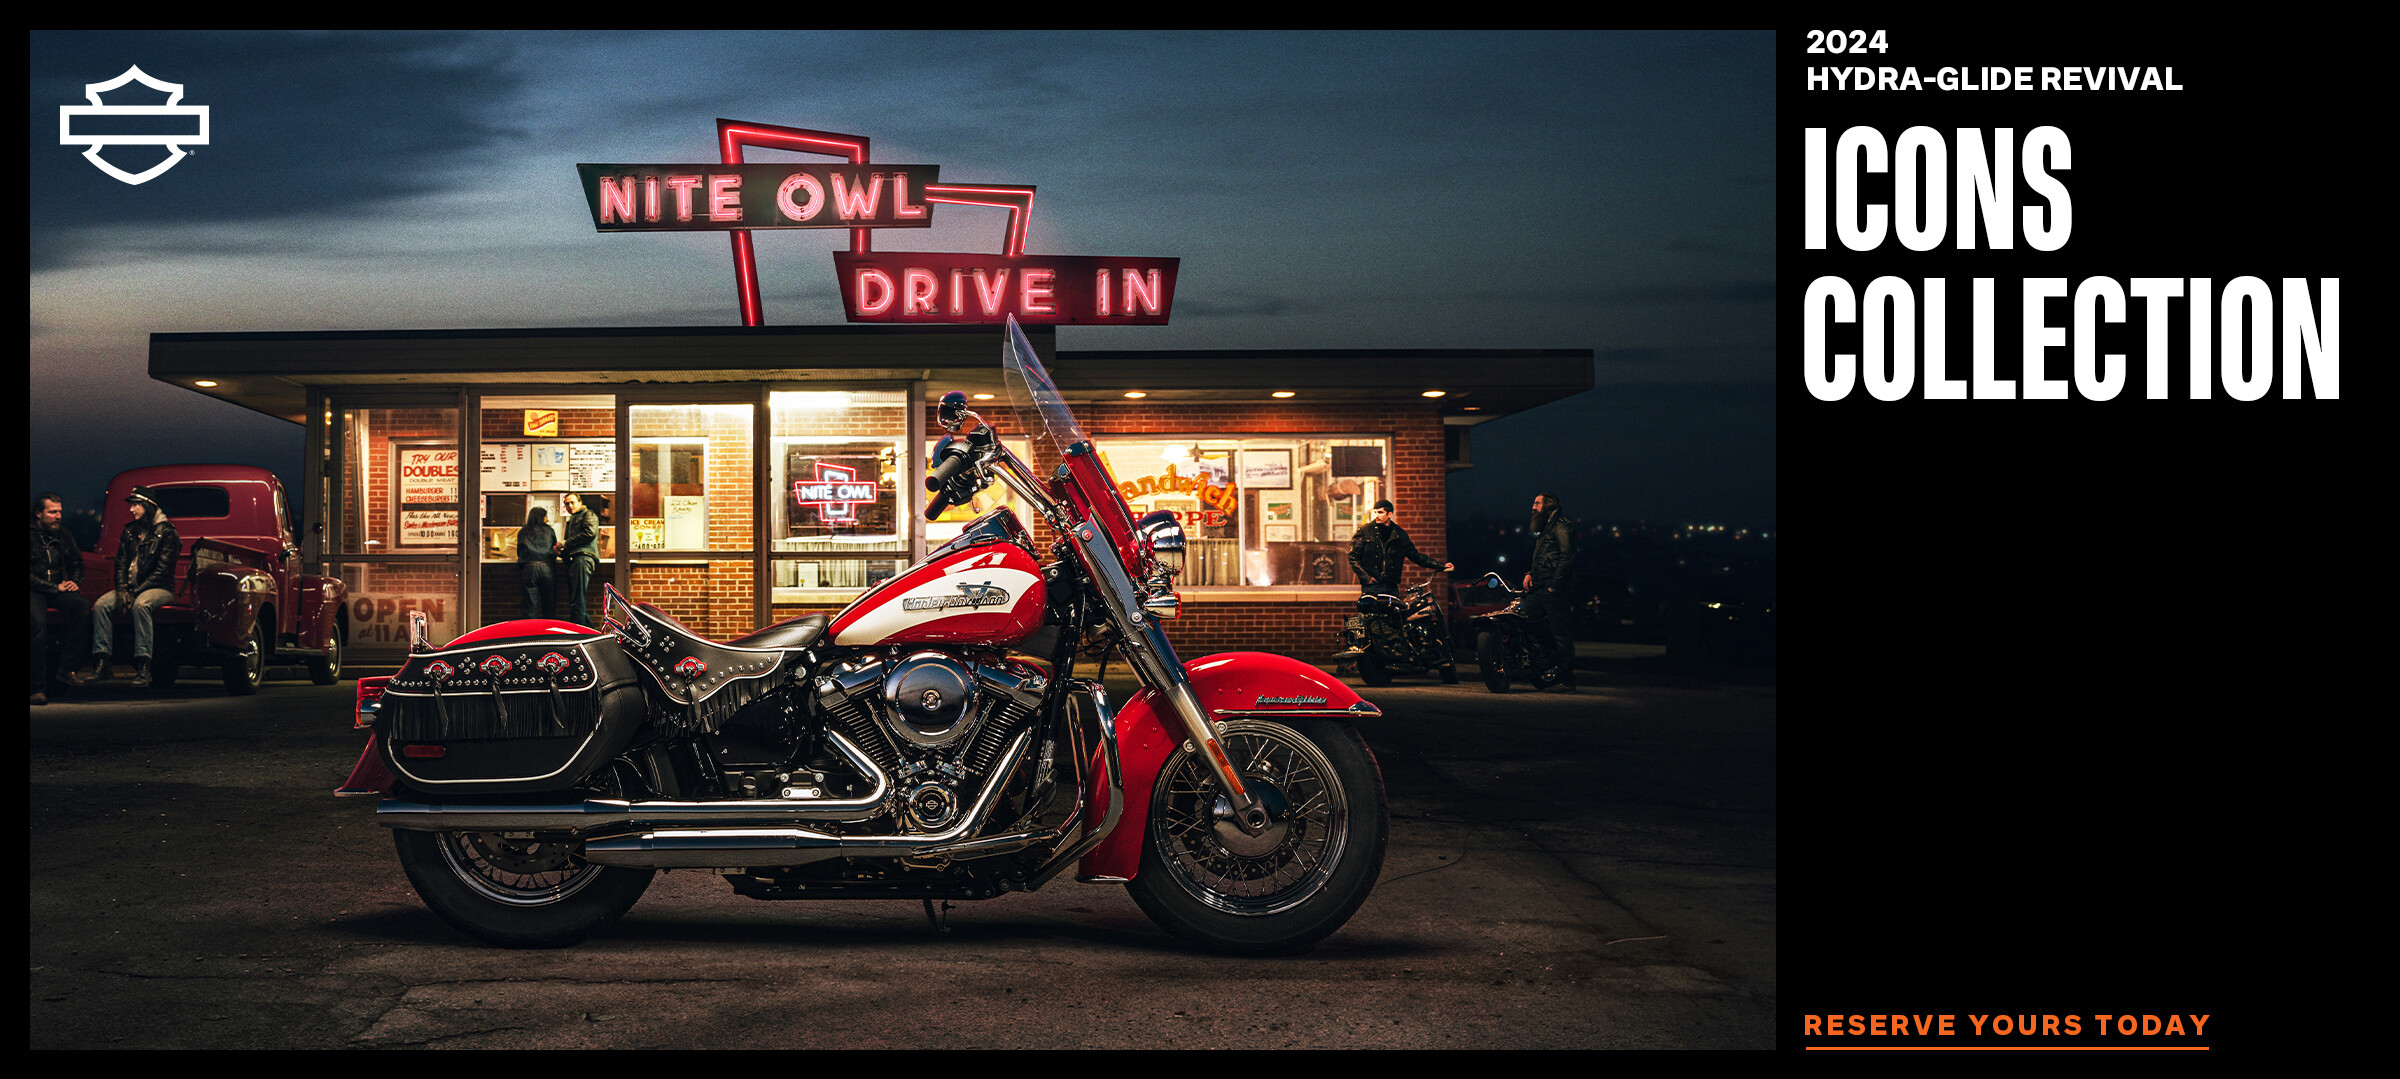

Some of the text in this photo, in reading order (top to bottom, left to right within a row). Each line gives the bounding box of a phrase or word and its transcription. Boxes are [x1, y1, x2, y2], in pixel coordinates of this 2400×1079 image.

[600, 172, 928, 223] NITE OWL
[854, 267, 1162, 317] DRIVE IN
[411, 452, 457, 465] TRY OUR
[403, 465, 459, 478] DOUBLES
[801, 485, 873, 500] NITE OWL
[1118, 463, 1238, 517] andwich
[353, 597, 445, 623] OPEN
[358, 624, 374, 639] at
